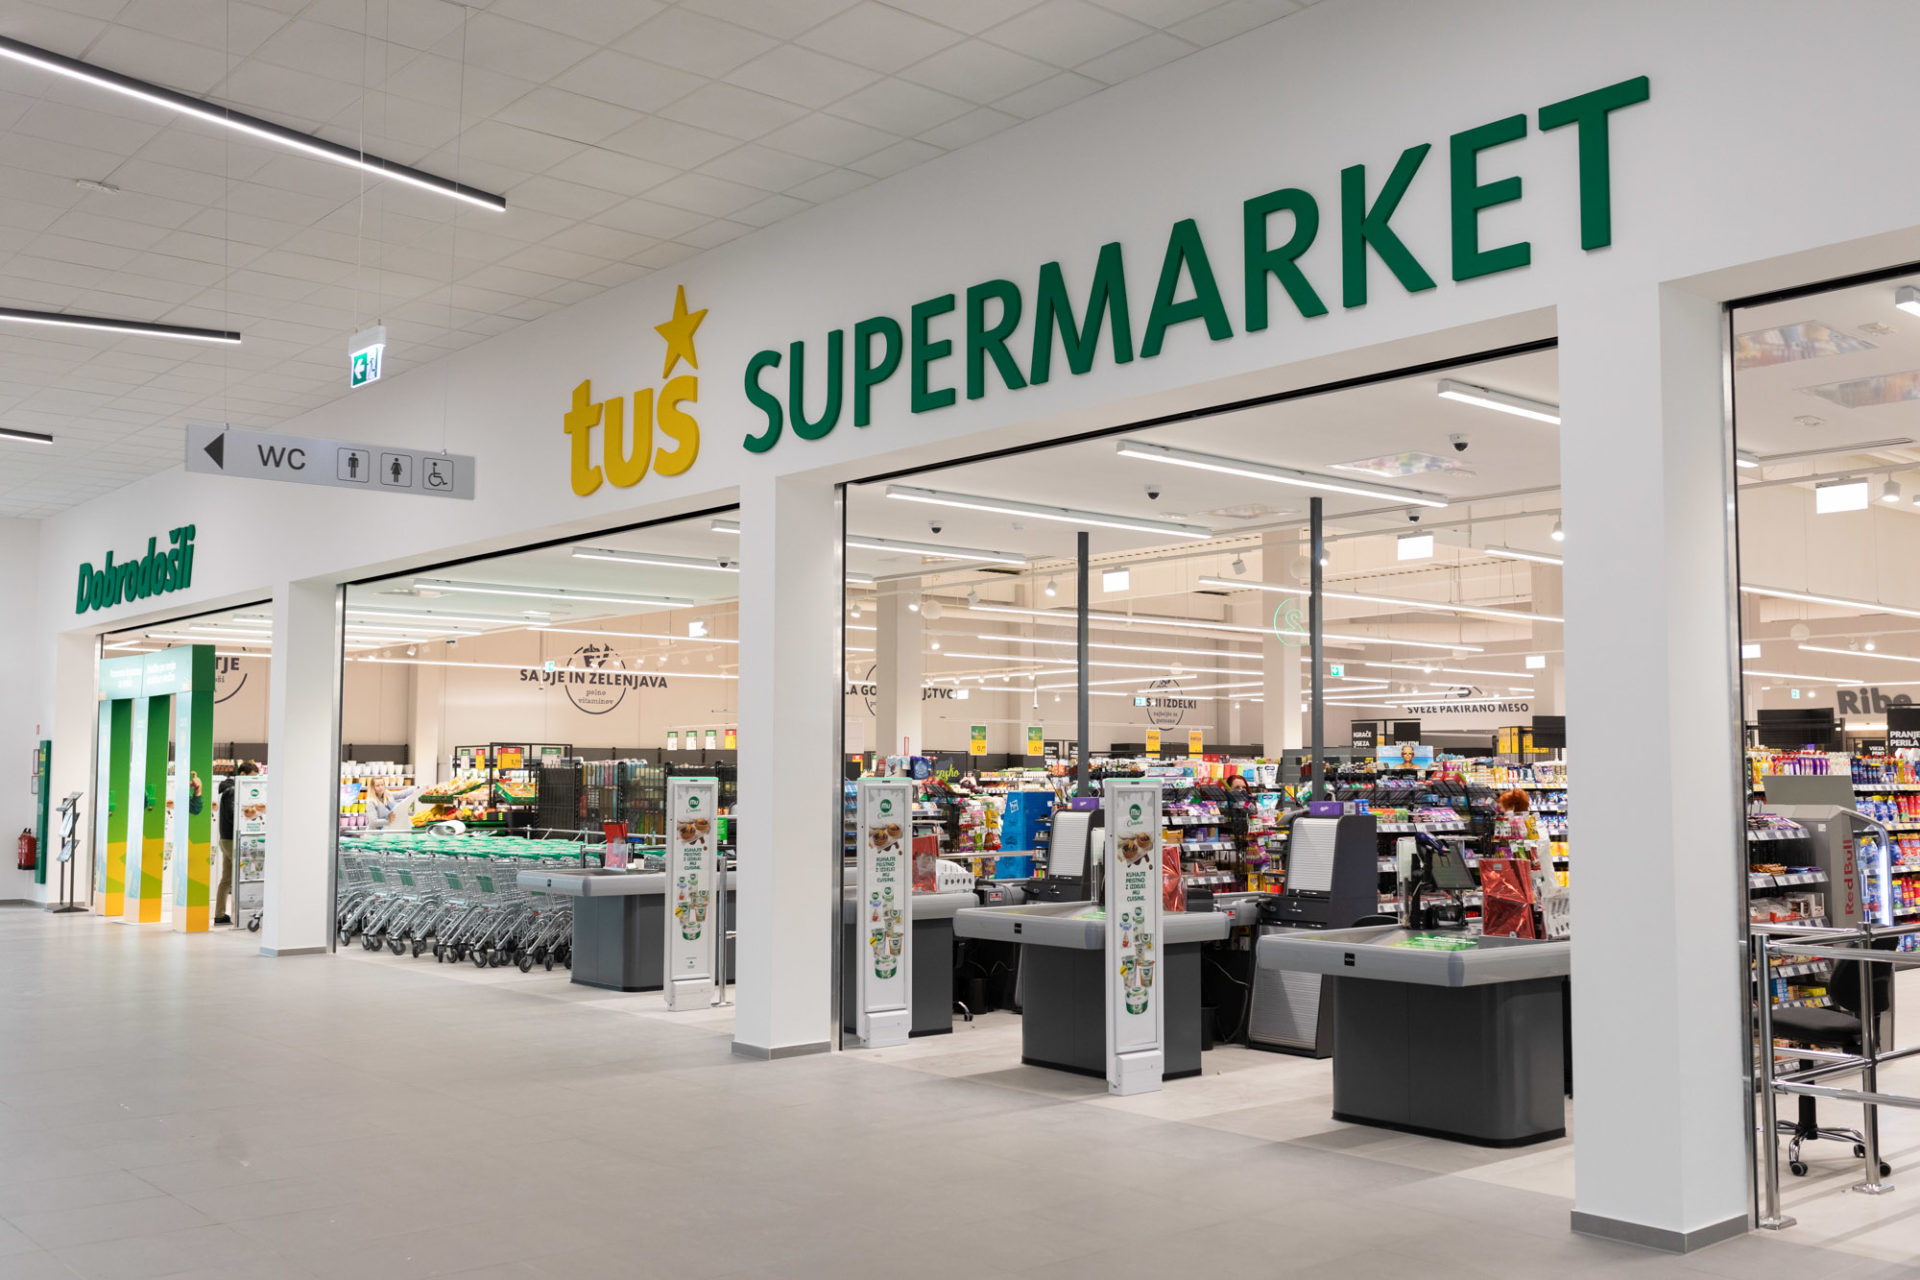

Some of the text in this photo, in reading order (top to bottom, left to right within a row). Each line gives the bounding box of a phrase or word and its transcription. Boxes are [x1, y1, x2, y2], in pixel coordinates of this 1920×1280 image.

[743, 75, 1651, 454] SUPERMARKET
[257, 443, 307, 471] WC
[75, 524, 196, 614] Dobrodošli
[569, 671, 587, 685] IN
[589, 672, 668, 690] ZELENJAVA
[1163, 698, 1197, 709] IZDELKI
[1440, 703, 1496, 713] PAKIRANO
[1498, 702, 1529, 713] MESO
[1889, 730, 1920, 739] PRANJE
[1890, 739, 1919, 747] PERILA
